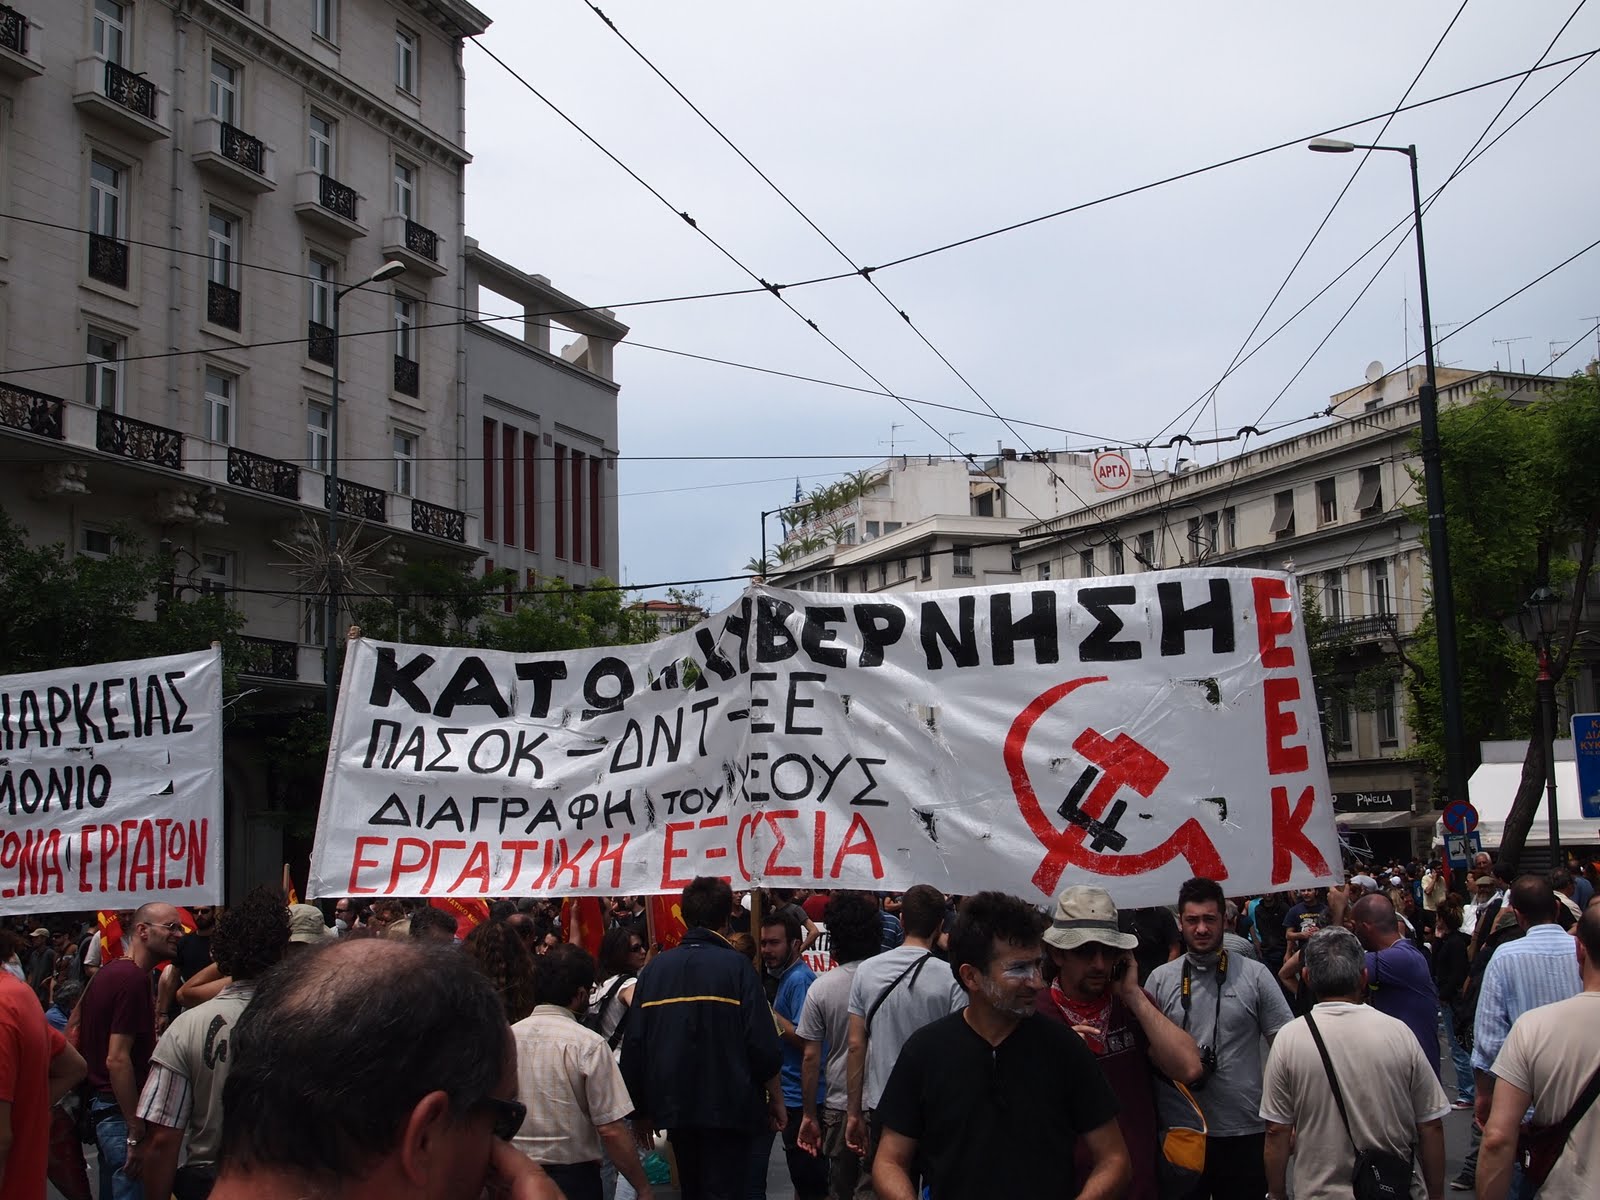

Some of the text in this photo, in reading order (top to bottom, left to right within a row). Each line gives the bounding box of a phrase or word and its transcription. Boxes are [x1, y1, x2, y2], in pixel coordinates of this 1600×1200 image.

[1099, 464, 1126, 479] ΑΡΓΑ
[0, 671, 193, 750] ΙΑΡΚΕΙΑΣ
[1252, 577, 1331, 886] ΕΕΕΚ
[363, 719, 549, 779] ΠΑΣΟΚ
[368, 789, 636, 835] ΔΙΑΓΡΑΦΗ
[661, 785, 723, 815] ΤΟΥ
[347, 833, 631, 895] ΕΡΓΑΤΙΚΗ
